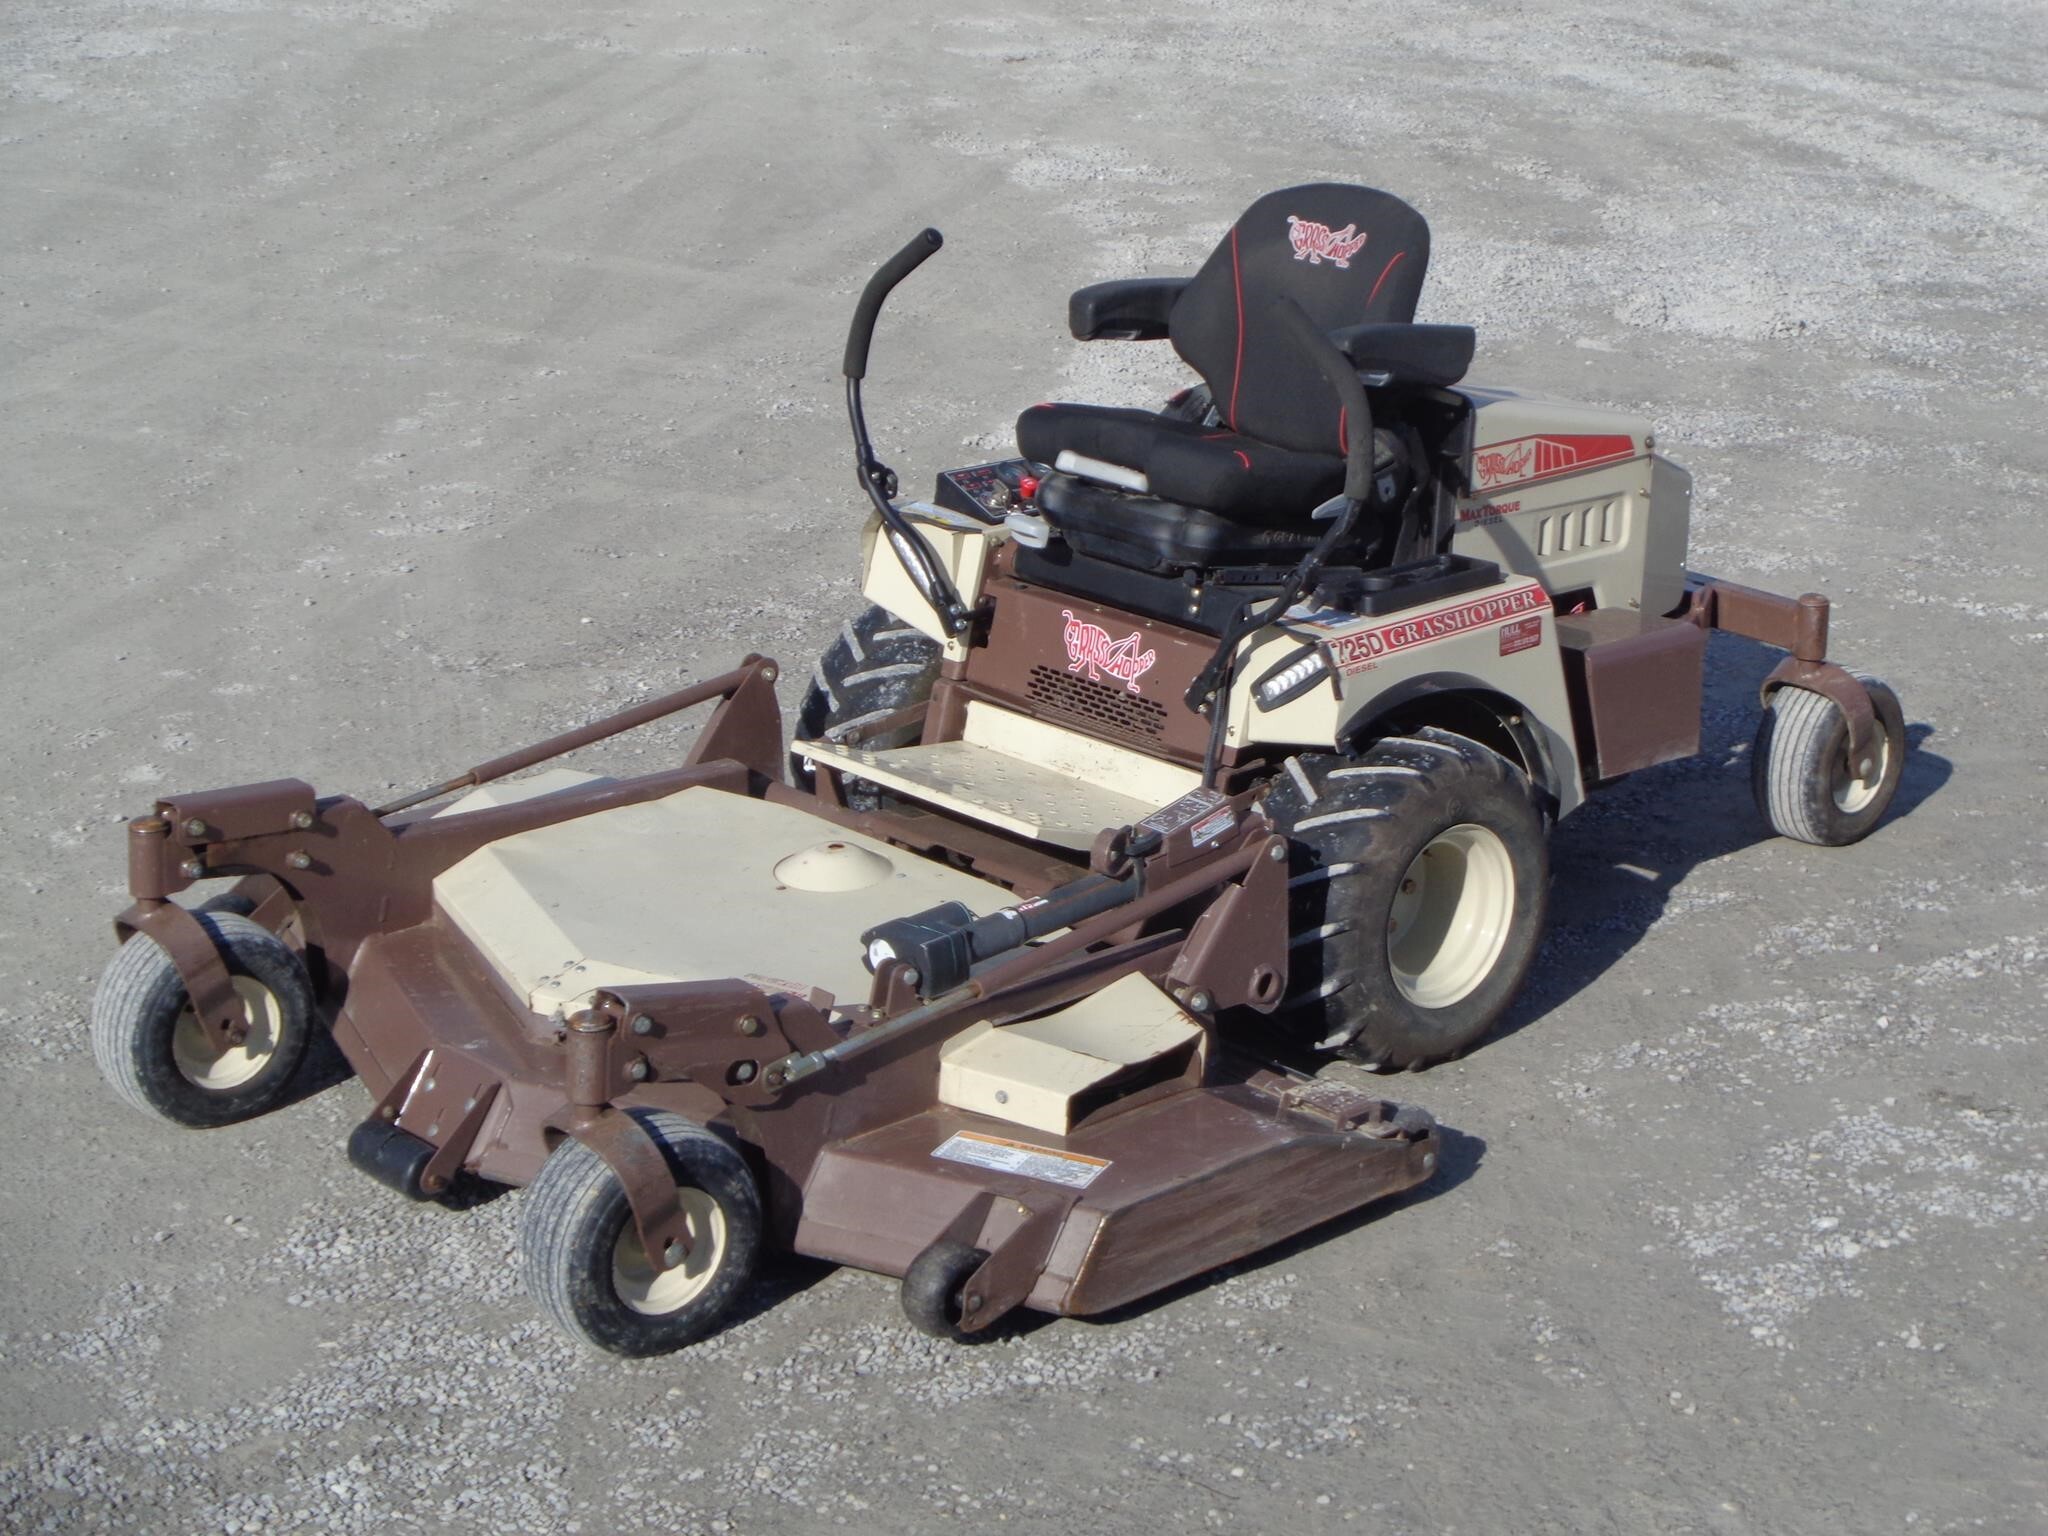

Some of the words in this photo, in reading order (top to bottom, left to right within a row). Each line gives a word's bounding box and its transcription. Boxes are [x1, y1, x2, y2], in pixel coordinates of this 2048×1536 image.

[1330, 632, 1384, 664] 725D
[1389, 591, 1538, 647] GRASSHOPPER
[1345, 662, 1378, 677] DIESEL
